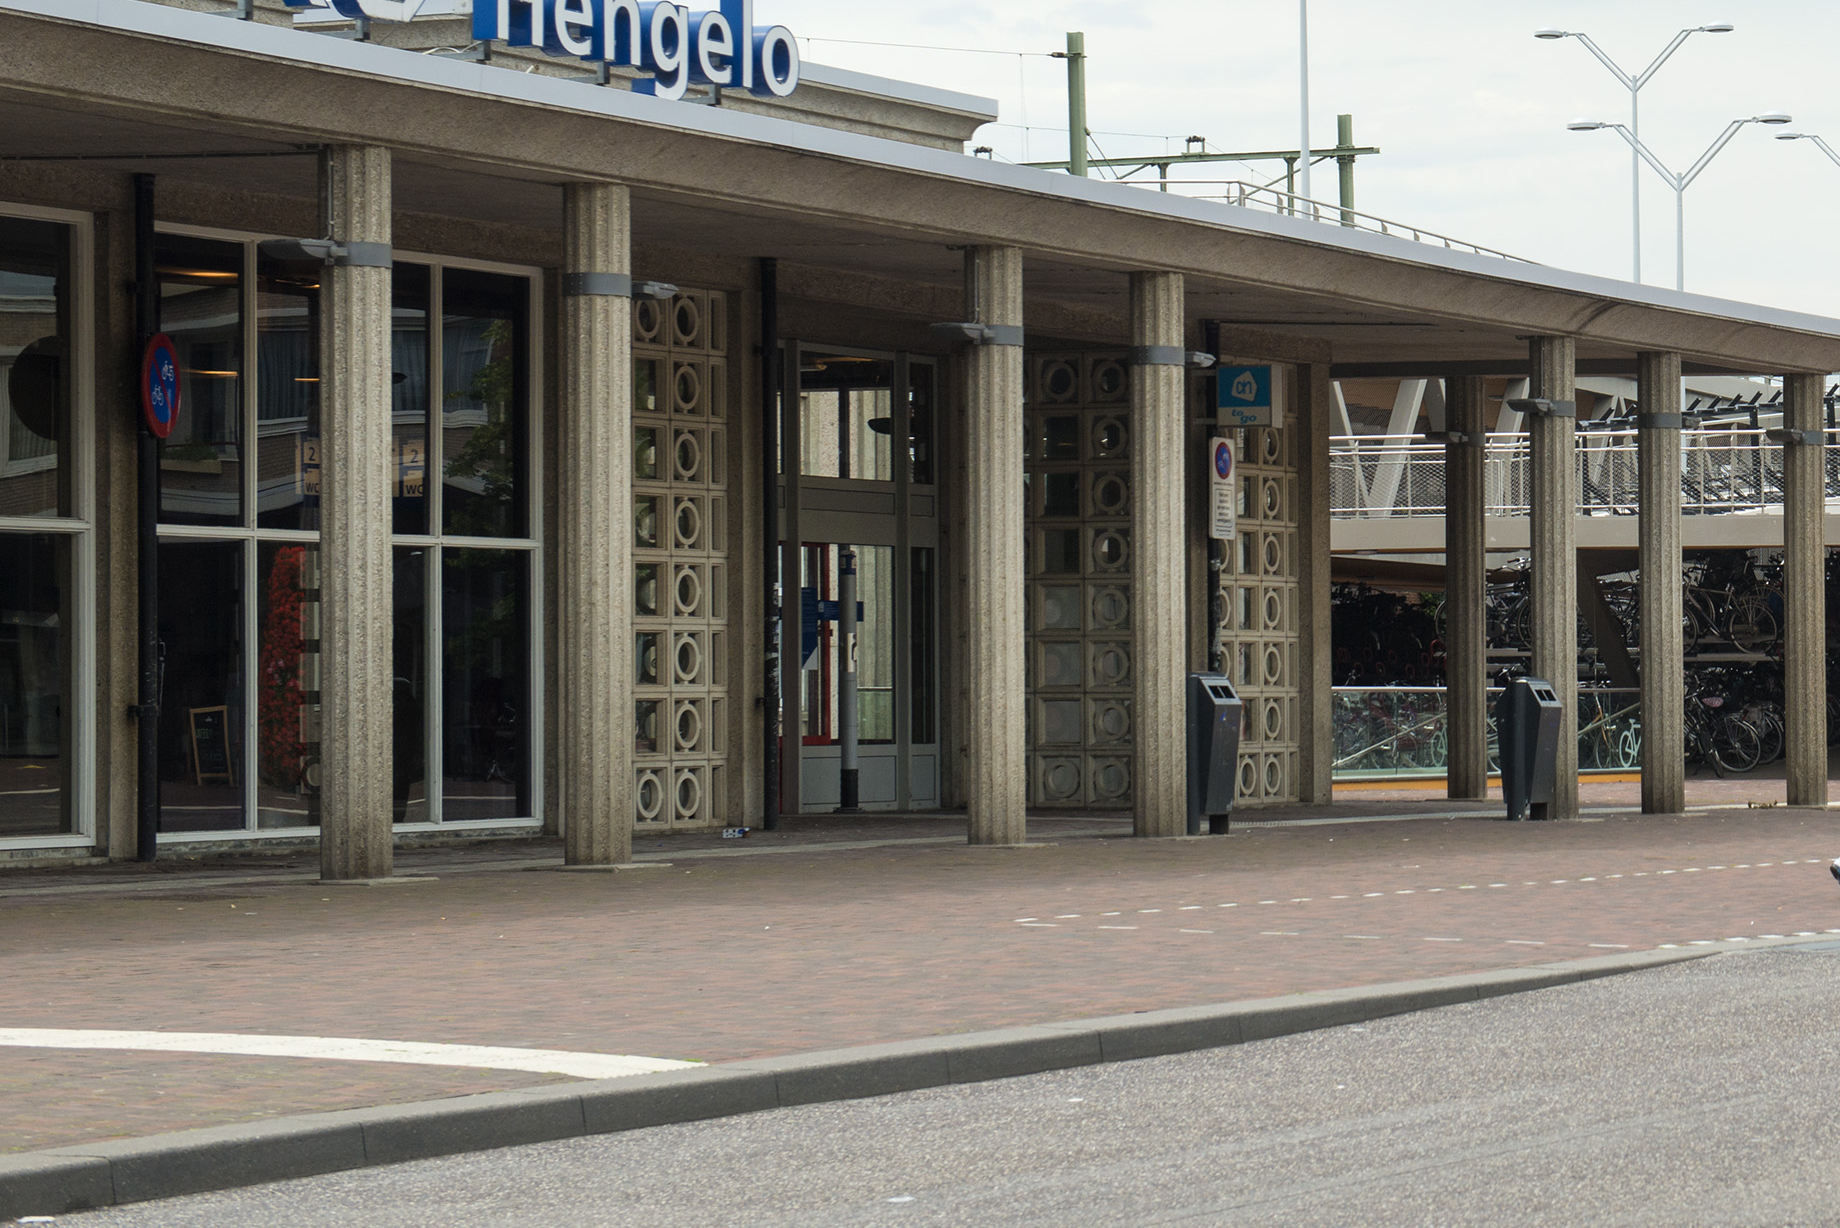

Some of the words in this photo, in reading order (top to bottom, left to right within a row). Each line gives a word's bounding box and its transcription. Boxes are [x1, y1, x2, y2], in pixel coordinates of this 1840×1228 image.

[1232, 409, 1244, 417] to
[1240, 414, 1257, 424] go
[308, 446, 316, 462] 2
[409, 448, 419, 464] 2
[305, 482, 320, 493] WC
[405, 484, 423, 495] WC
